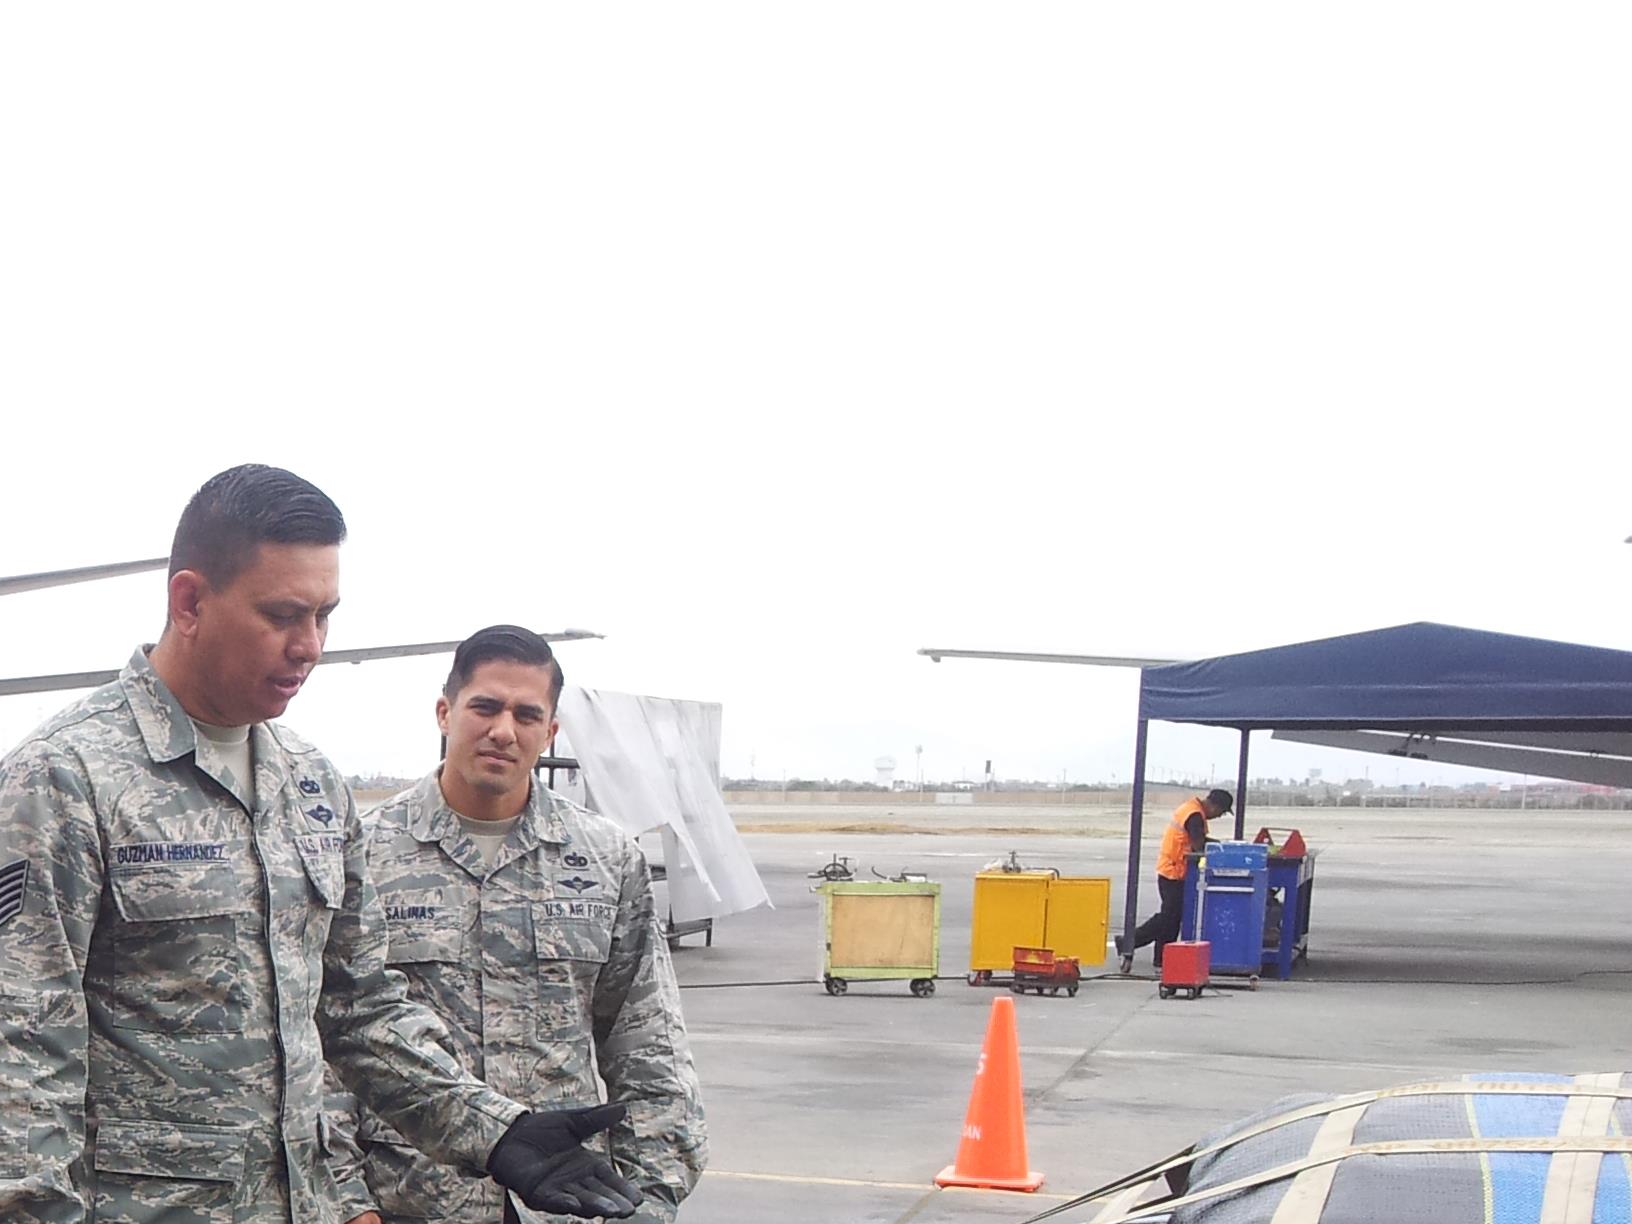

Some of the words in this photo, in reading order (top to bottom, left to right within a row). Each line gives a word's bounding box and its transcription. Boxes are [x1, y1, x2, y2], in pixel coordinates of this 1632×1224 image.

[117, 843, 164, 864] GUZMAN
[167, 843, 229, 861] HERNANDEZ
[385, 906, 436, 920] SALINAS
[569, 902, 584, 916] AIR
[588, 904, 613, 919] FORCE
